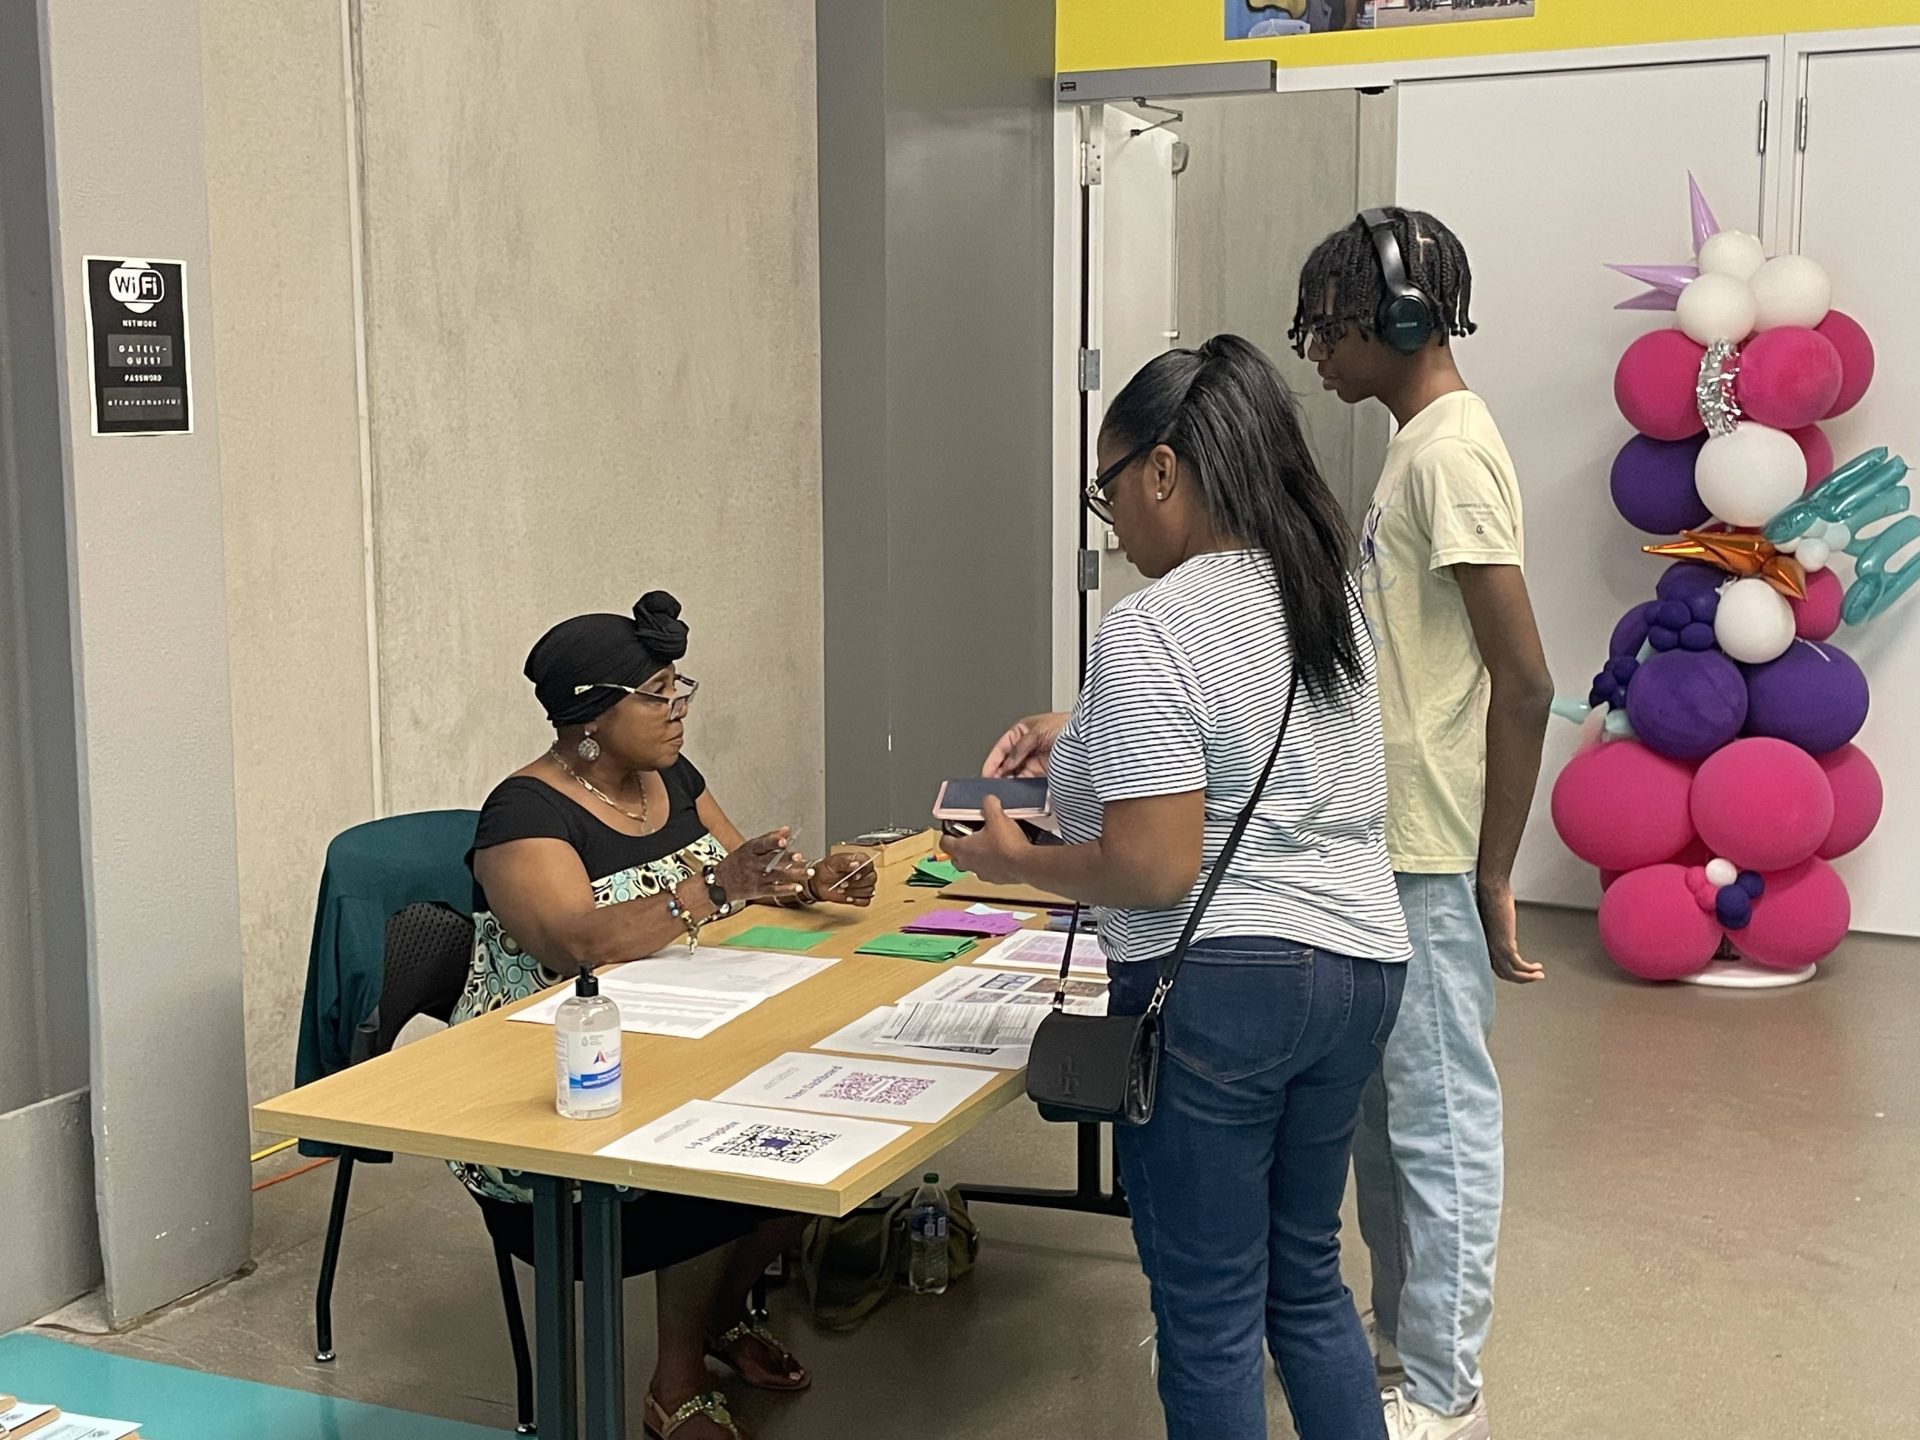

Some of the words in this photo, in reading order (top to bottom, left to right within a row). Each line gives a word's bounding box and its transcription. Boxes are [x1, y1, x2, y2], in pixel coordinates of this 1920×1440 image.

[114, 275, 158, 296] WiFi
[122, 319, 157, 328] NETWORK
[124, 374, 162, 382] PASSWORD
